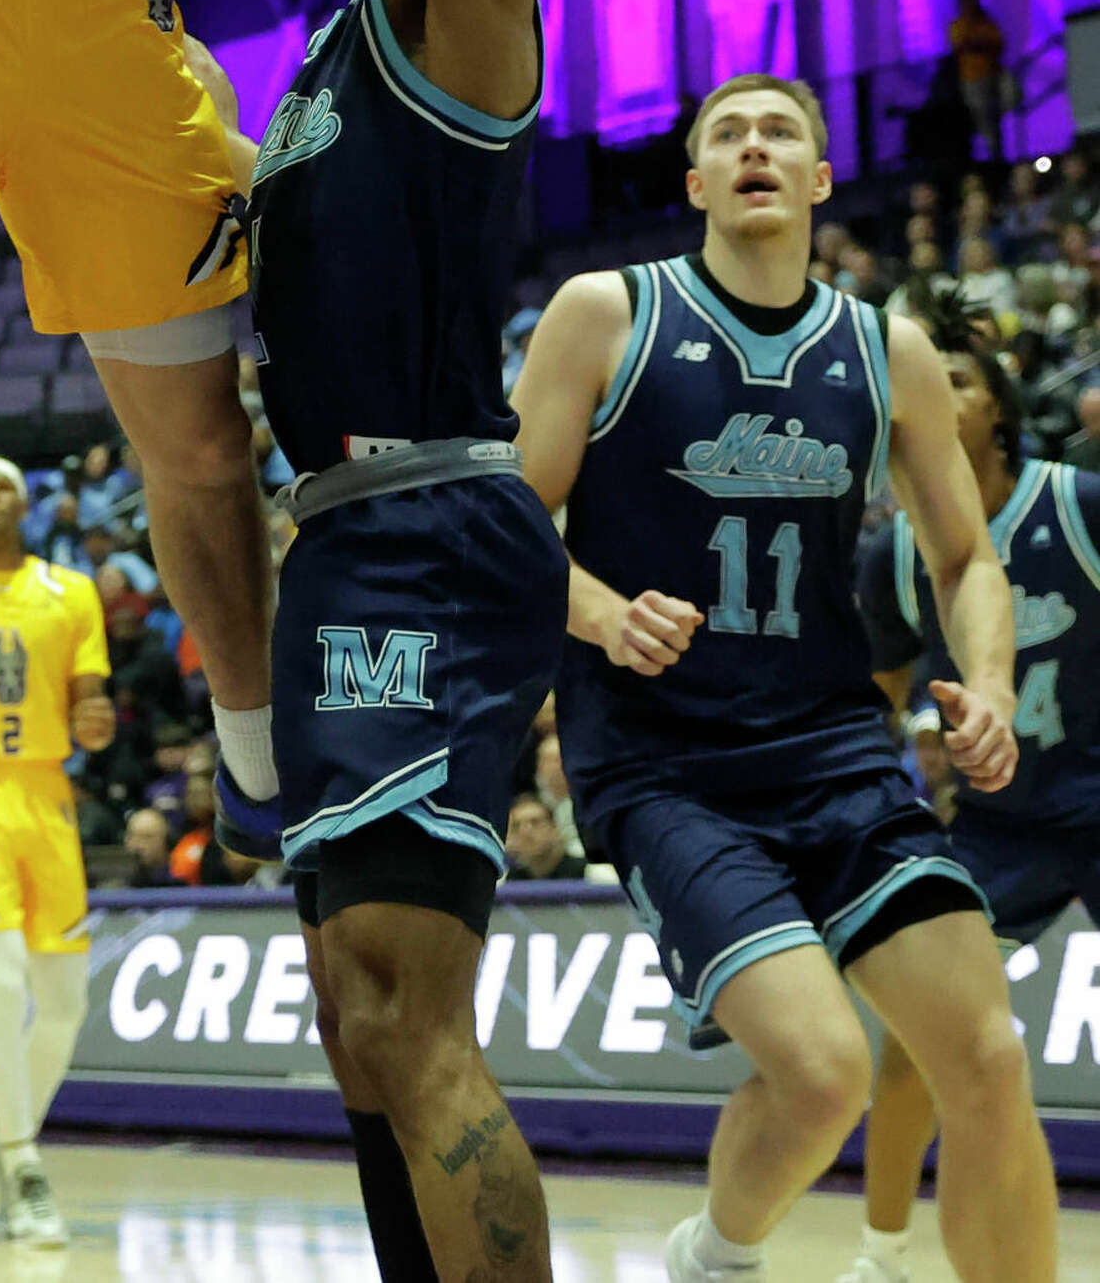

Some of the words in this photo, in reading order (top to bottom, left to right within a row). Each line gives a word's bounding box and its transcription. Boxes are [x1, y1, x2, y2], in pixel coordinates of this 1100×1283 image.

[666, 413, 853, 498] Maine
[708, 516, 803, 639] 11
[315, 625, 437, 711] M
[3, 715, 23, 754] 2
[109, 933, 675, 1053] CREIVE
